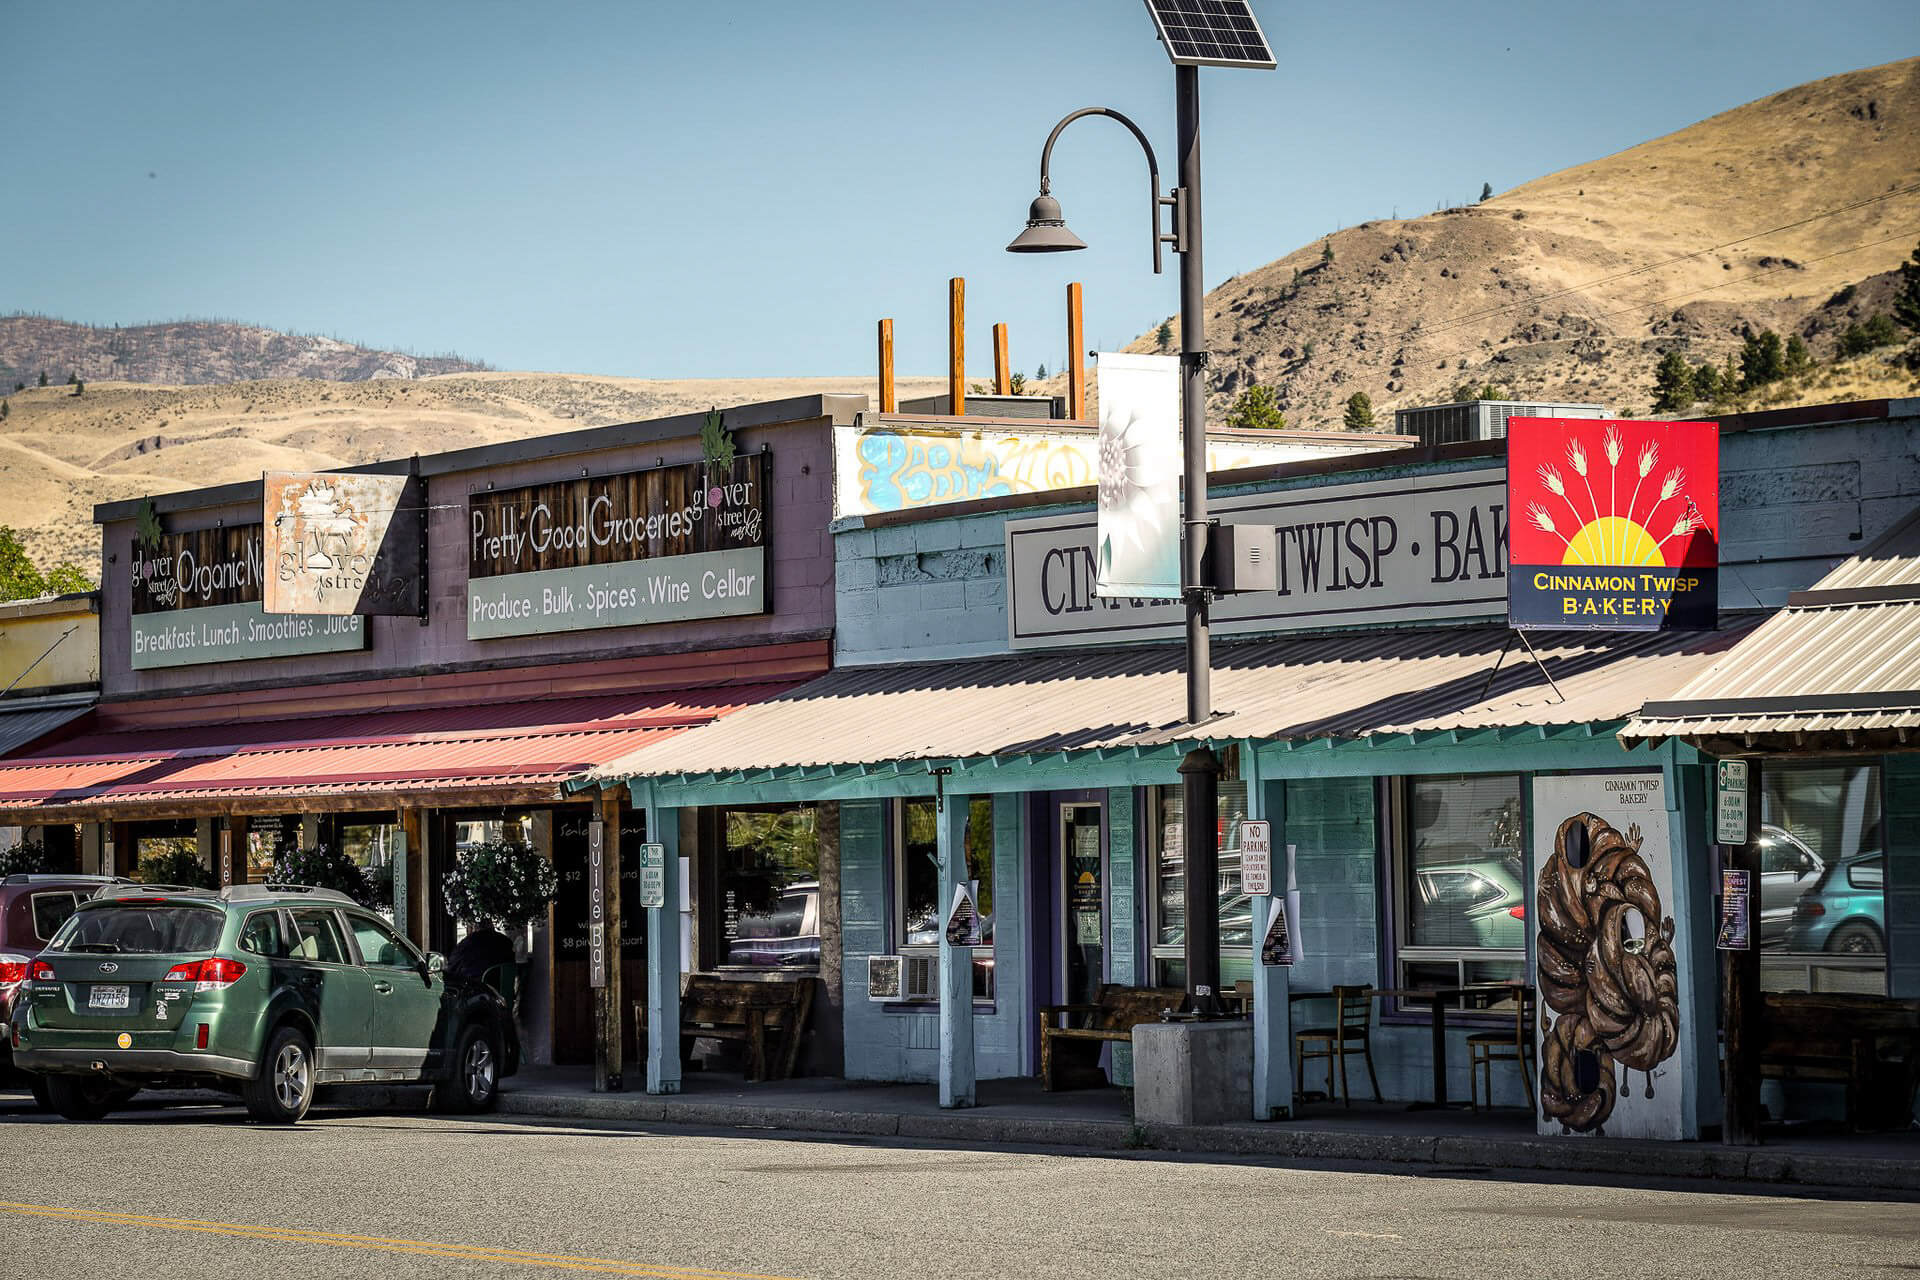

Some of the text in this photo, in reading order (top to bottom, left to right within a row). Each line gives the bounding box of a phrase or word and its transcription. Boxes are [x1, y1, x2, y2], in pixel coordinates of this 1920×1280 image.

[718, 509, 747, 527] street
[473, 495, 693, 565] Pretty Good Groceries
[1275, 515, 1398, 597] TWISP
[1430, 504, 1509, 584] BAK
[177, 549, 245, 600] Organic
[1533, 572, 1700, 592] CINNAMON TWISP
[472, 567, 756, 623] Produce Bulk Spices Wine Cellar
[135, 614, 358, 654] Breakfast Lunch Smoothies Juice
[1638, 779, 1660, 791] TWISP
[1619, 792, 1648, 804] BAKERY
[1249, 826, 1261, 838] NO
[642, 848, 648, 865] 3
[1243, 840, 1268, 853] PARKING
[592, 828, 602, 981] Juice Bar
